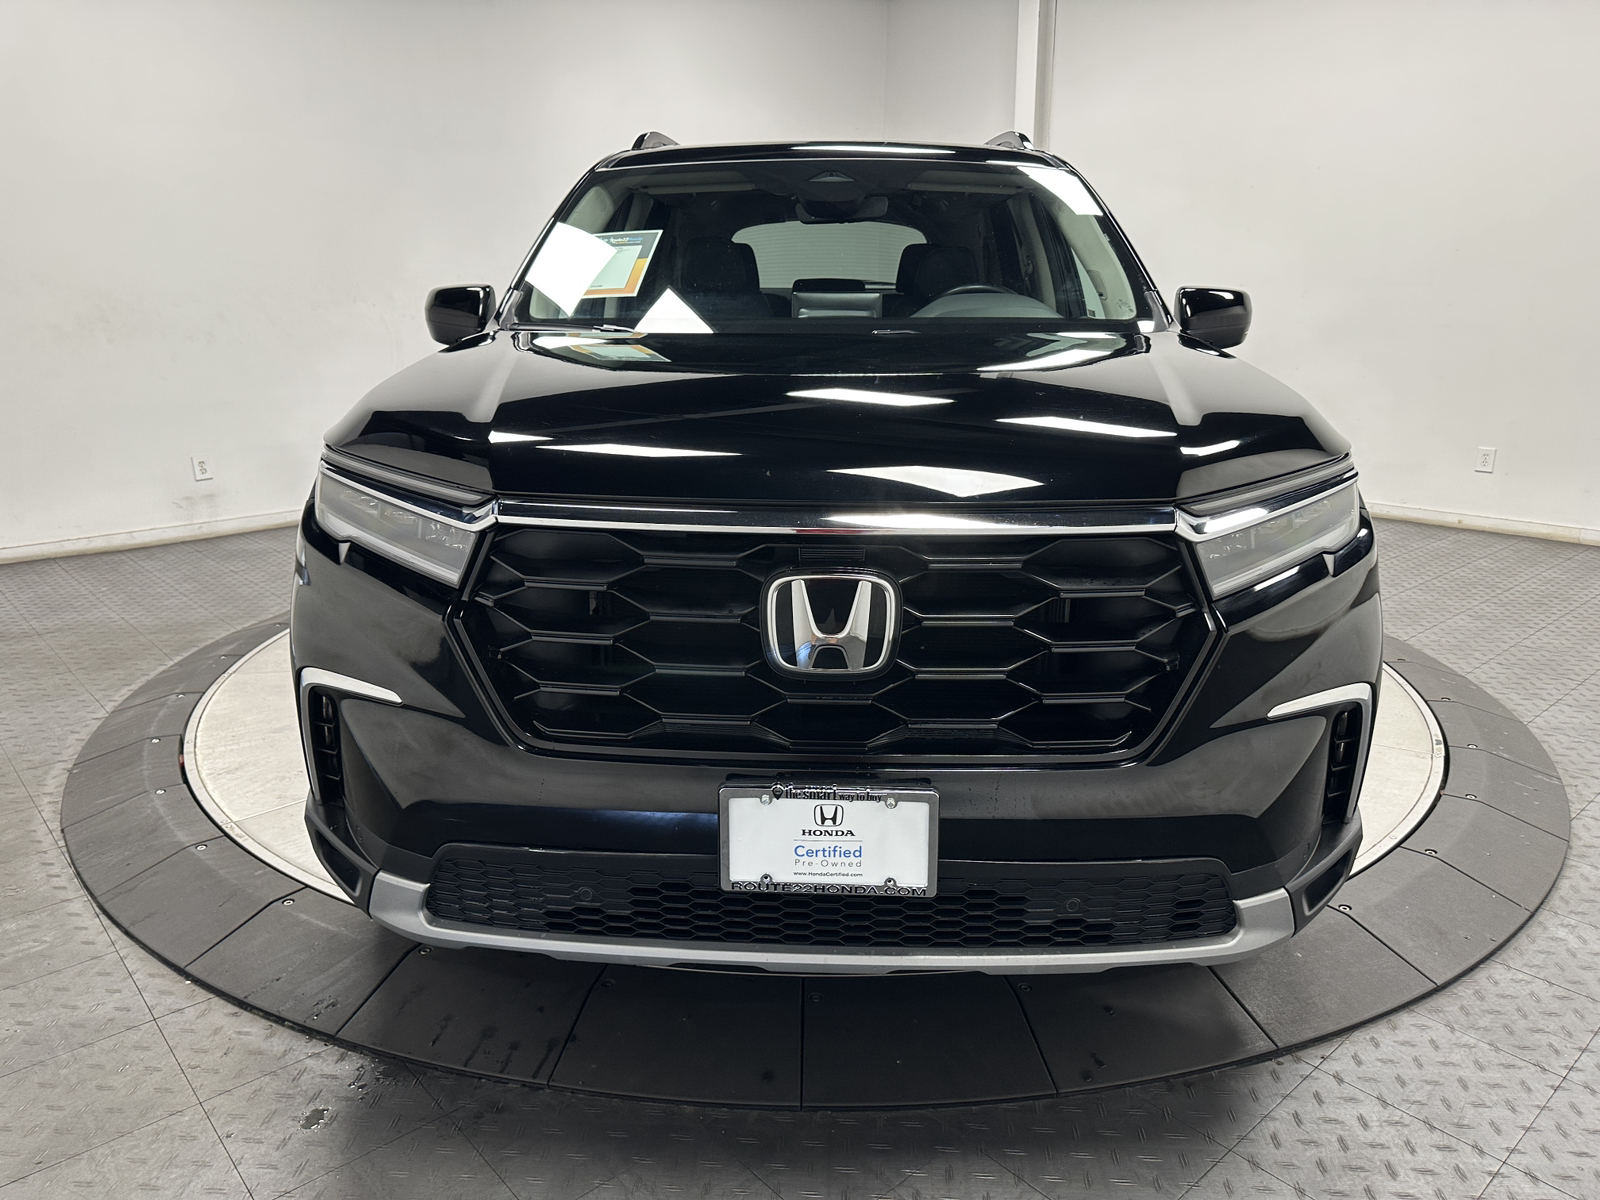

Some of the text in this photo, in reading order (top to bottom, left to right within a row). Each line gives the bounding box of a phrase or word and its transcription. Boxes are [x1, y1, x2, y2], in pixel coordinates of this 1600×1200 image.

[785, 786, 882, 803] the smart way to buy
[801, 829, 856, 837] HONDA
[794, 844, 863, 858] Certified
[794, 858, 862, 868] Pre-Owned
[793, 870, 864, 878] www.HondaCertified.com
[731, 882, 927, 897] ROUTE22HONDA.COM
